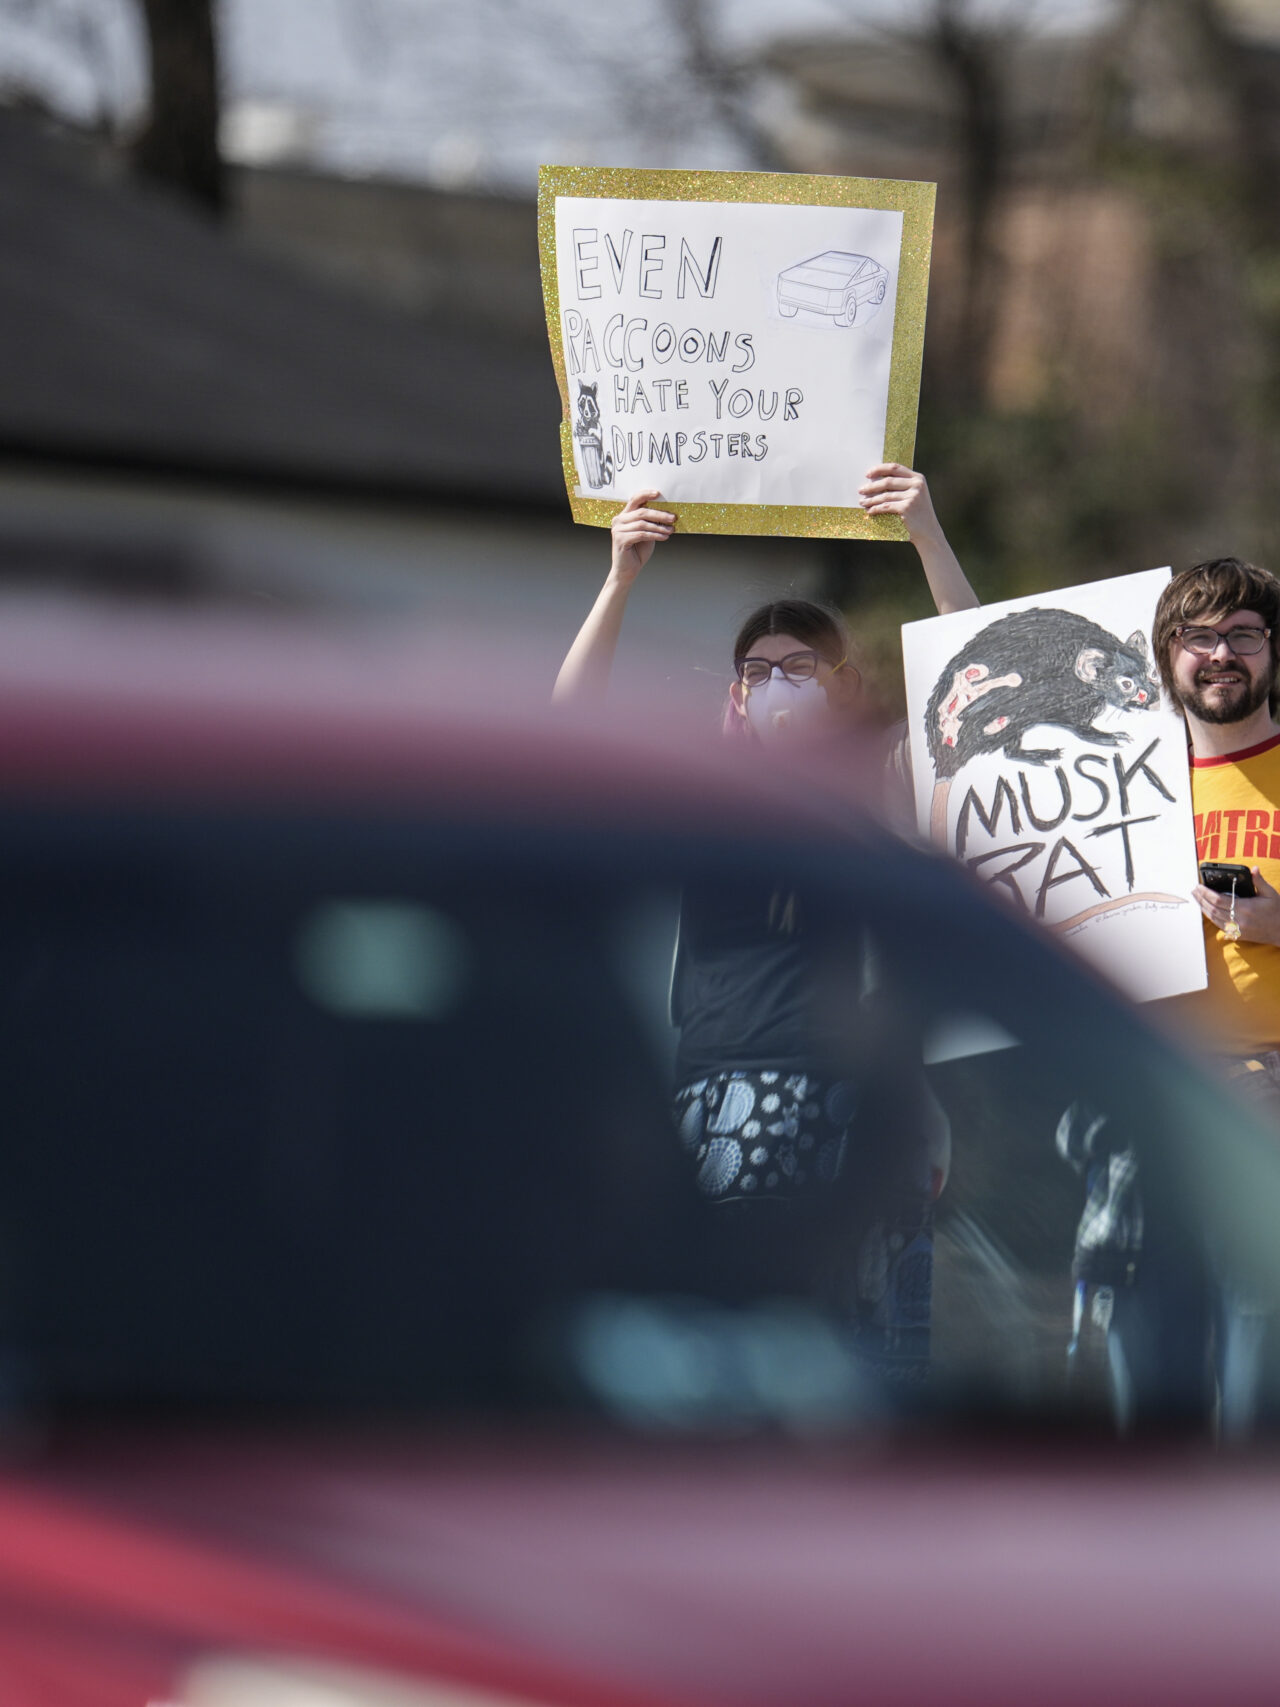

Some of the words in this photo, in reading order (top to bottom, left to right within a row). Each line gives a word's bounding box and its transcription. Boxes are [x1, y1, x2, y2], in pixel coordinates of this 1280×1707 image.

[572, 228, 723, 300] EVEN
[563, 309, 756, 375] RACCOONS
[613, 375, 690, 414] HATE
[708, 378, 804, 421] YOUR
[611, 425, 769, 473] DUMPSTERS
[956, 737, 1177, 858] MUSK
[966, 814, 1161, 918] RAT
